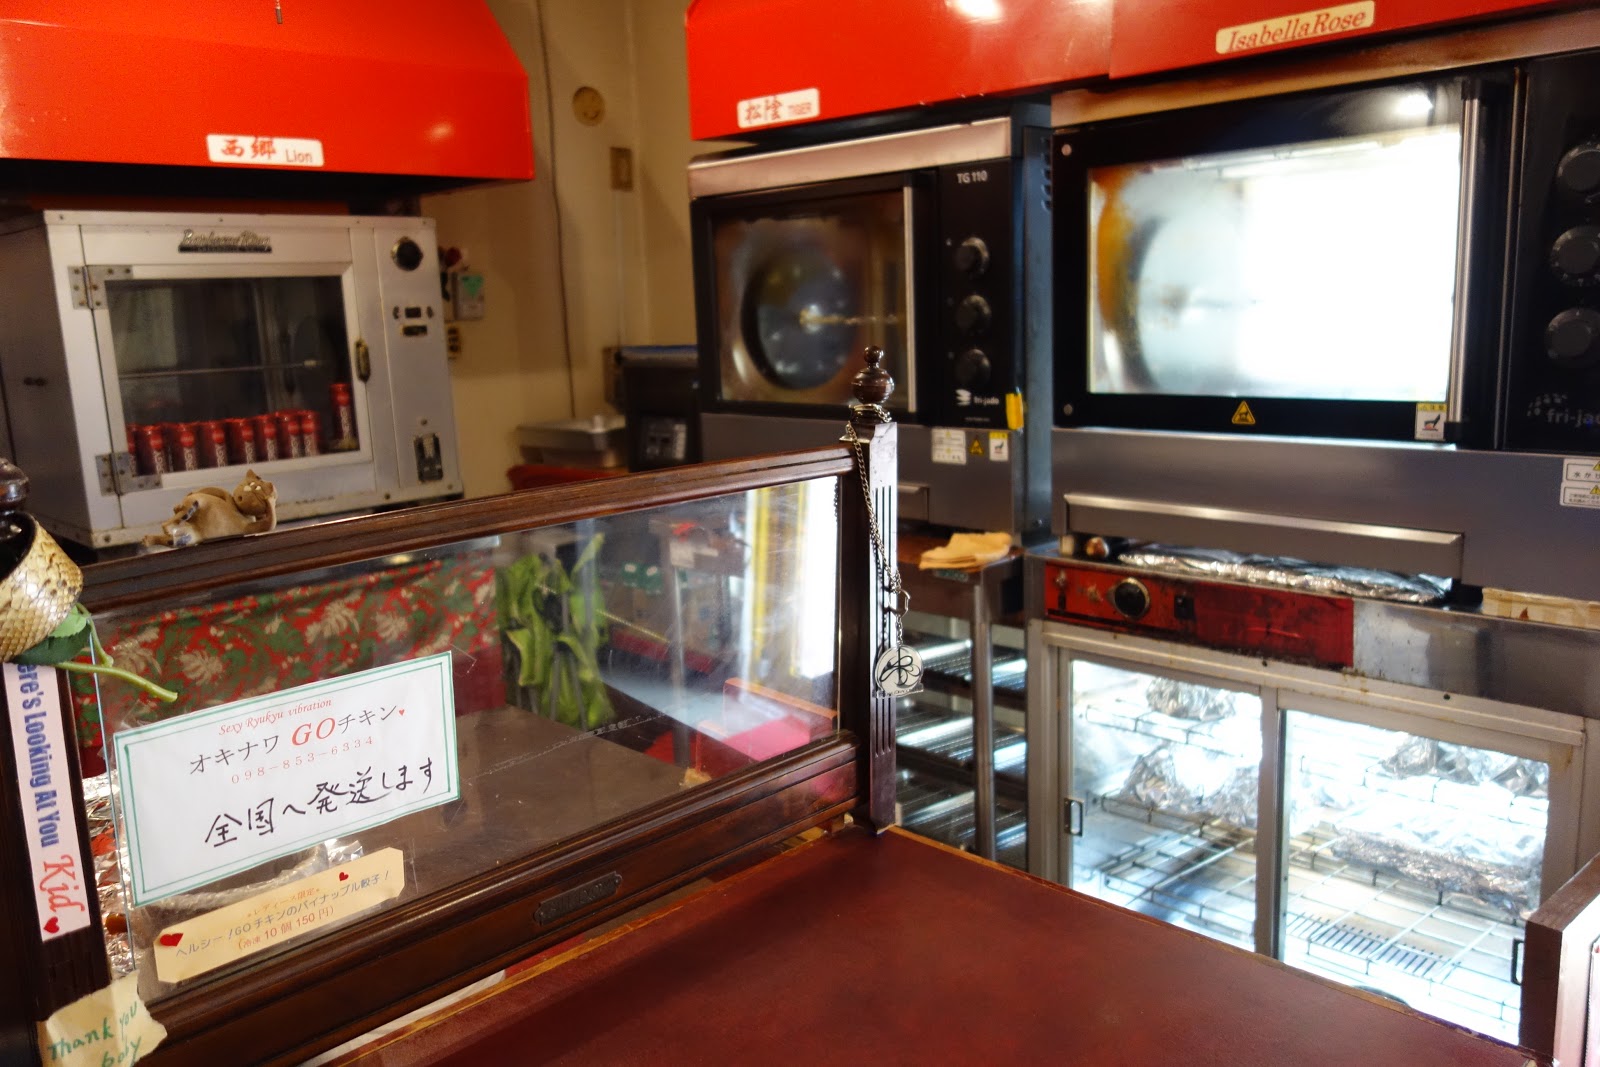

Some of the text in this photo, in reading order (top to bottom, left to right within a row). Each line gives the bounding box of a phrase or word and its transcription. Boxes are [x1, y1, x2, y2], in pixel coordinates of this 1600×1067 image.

[1227, 11, 1367, 51] IsabellaRose
[285, 149, 313, 163] Lion
[956, 170, 988, 184] TG 110
[218, 698, 332, 736] Sexy Ryukyu vibration
[189, 734, 280, 775] オキナワ
[17, 664, 86, 913] ere's Looking At You Kid
[204, 756, 433, 848] 全国へ発送します
